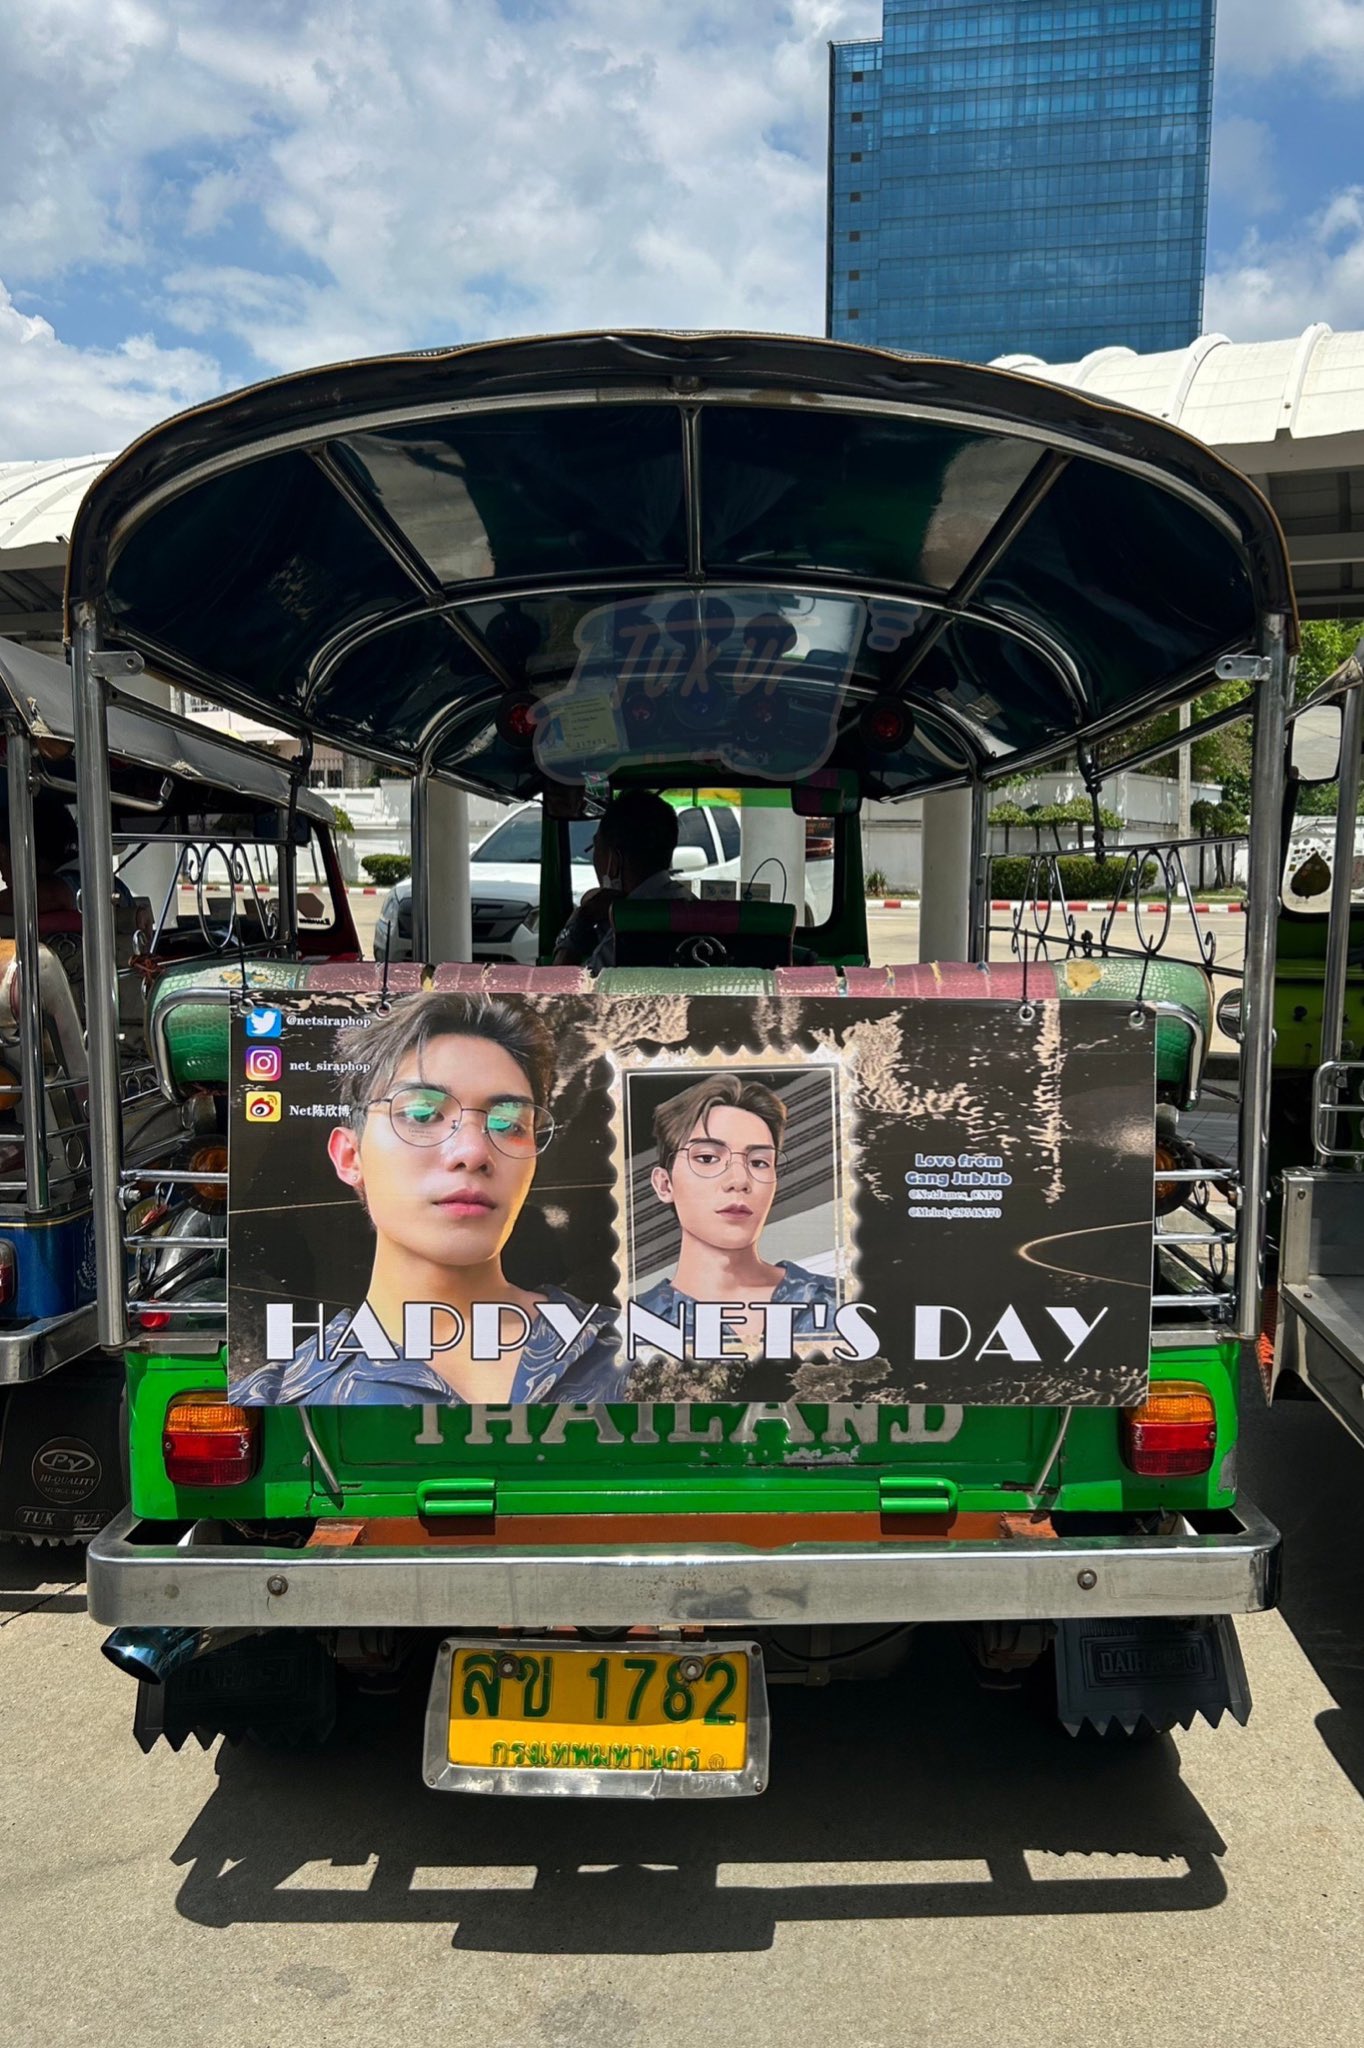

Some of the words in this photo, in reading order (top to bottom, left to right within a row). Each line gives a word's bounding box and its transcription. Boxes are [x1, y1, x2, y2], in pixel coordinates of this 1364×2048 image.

[286, 1014, 371, 1029] @netsiraphop
[289, 1060, 371, 1074] net_siraphop
[289, 1103, 351, 1119] Net陈欣博
[915, 1153, 956, 1167] Love
[958, 1153, 1003, 1168] from
[904, 1171, 949, 1187] Gang
[951, 1172, 1013, 1186] JubJub
[266, 1301, 600, 1361] HAPPY
[627, 1301, 881, 1362] NET'S
[914, 1304, 1109, 1362] DAY
[403, 1403, 964, 1445] THAILAND
[51, 1453, 85, 1471] PY
[23, 1510, 56, 1526] TUK
[588, 1658, 737, 1725] 1782
[491, 1740, 701, 1771] กรงเทพมหานคร
